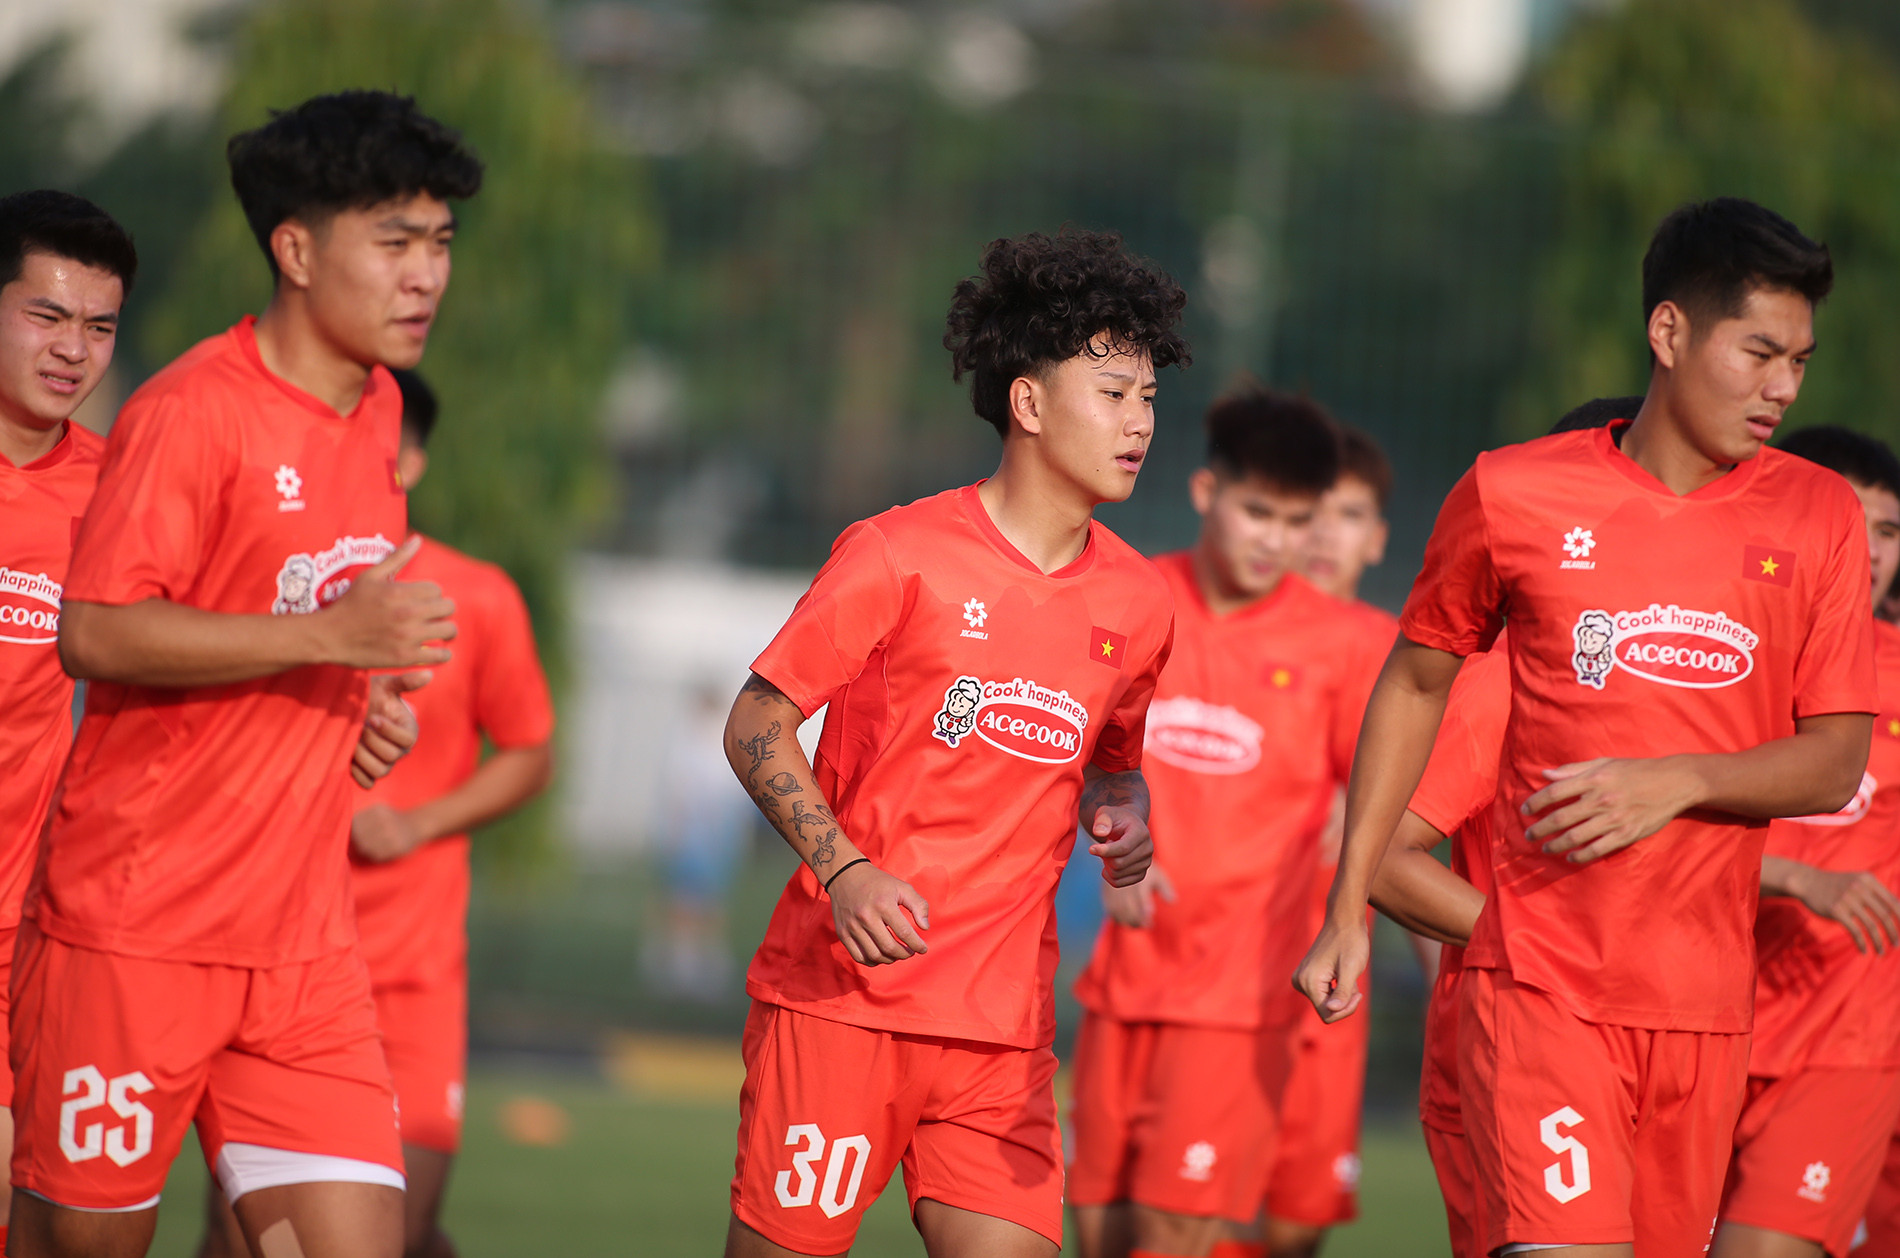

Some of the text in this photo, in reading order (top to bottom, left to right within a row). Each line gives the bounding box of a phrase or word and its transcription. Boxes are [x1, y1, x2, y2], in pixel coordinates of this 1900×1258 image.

[0, 571, 61, 599] happine
[1617, 609, 1756, 649] Cook happiness
[983, 682, 1087, 727] Cook happiness
[58, 1064, 155, 1168] 25
[774, 1123, 872, 1219] 30
